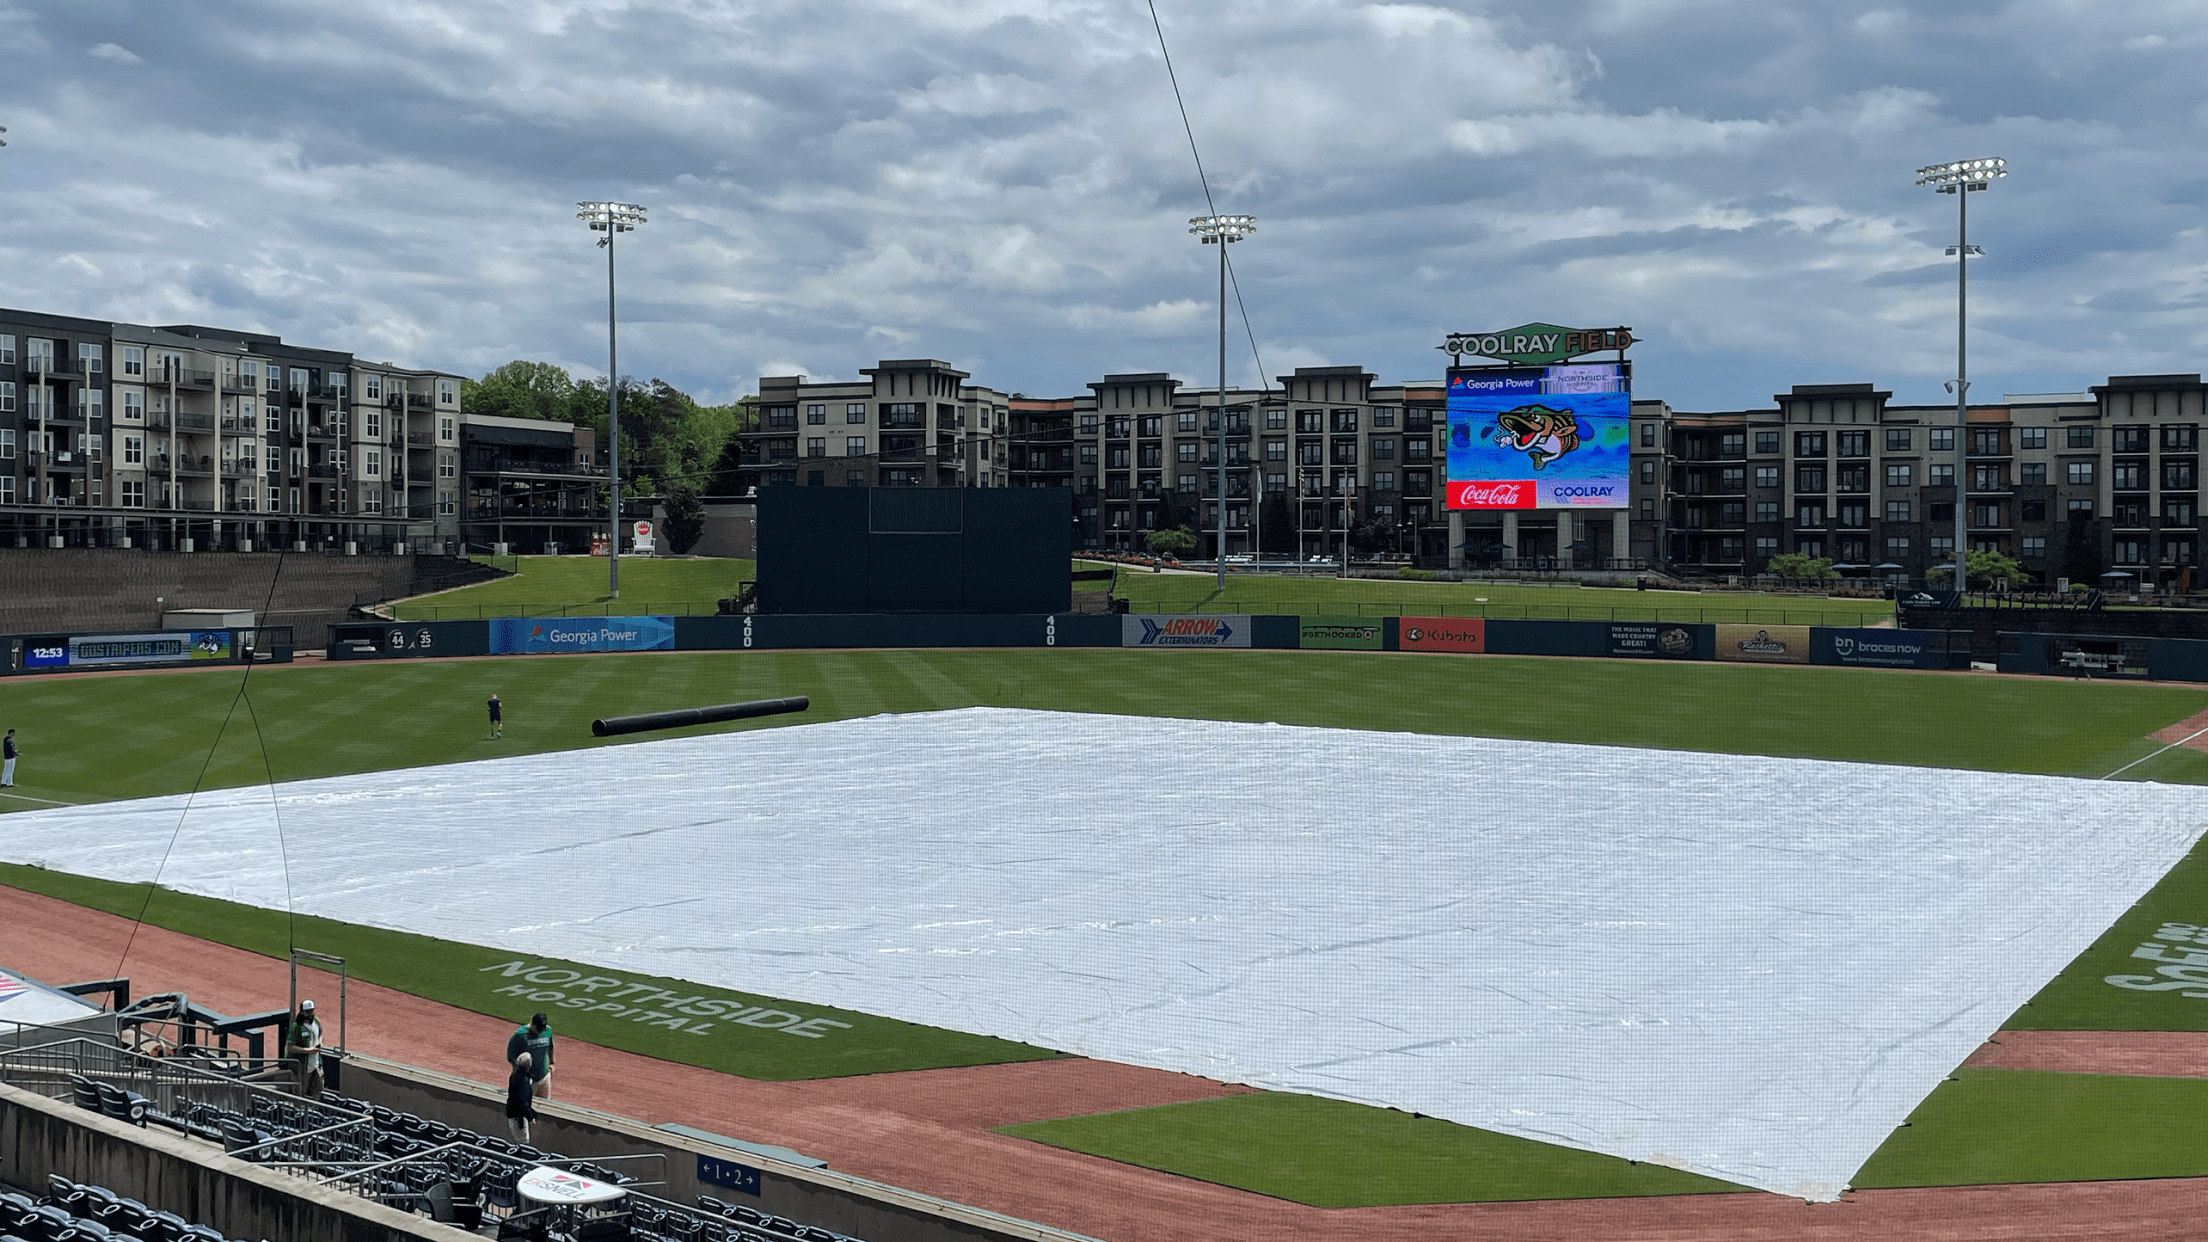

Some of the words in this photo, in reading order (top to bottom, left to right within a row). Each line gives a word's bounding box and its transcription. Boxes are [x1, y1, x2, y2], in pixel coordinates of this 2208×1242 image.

[1445, 333, 1560, 356] COOLRAY
[1565, 330, 1633, 352] FIELD
[1467, 379, 1504, 390] Georgia
[1505, 378, 1535, 388] Power
[1557, 374, 1608, 382] NORTHSIDE
[1553, 486, 1615, 497] COOLRAY
[1161, 619, 1221, 635] ARROW
[391, 635, 404, 645] 44
[420, 634, 432, 644] 35
[550, 628, 598, 645] Georgia
[600, 628, 638, 641] Power
[1158, 636, 1218, 645] EXTERMINATORS
[1302, 631, 1362, 639] #GETHOOKED
[1427, 630, 1477, 642] Kubota
[33, 647, 63, 659] 12:53
[479, 961, 853, 1039] NORTHSIDE
[492, 983, 716, 1035] HOSPITAL
[734, 1169, 742, 1185] 2
